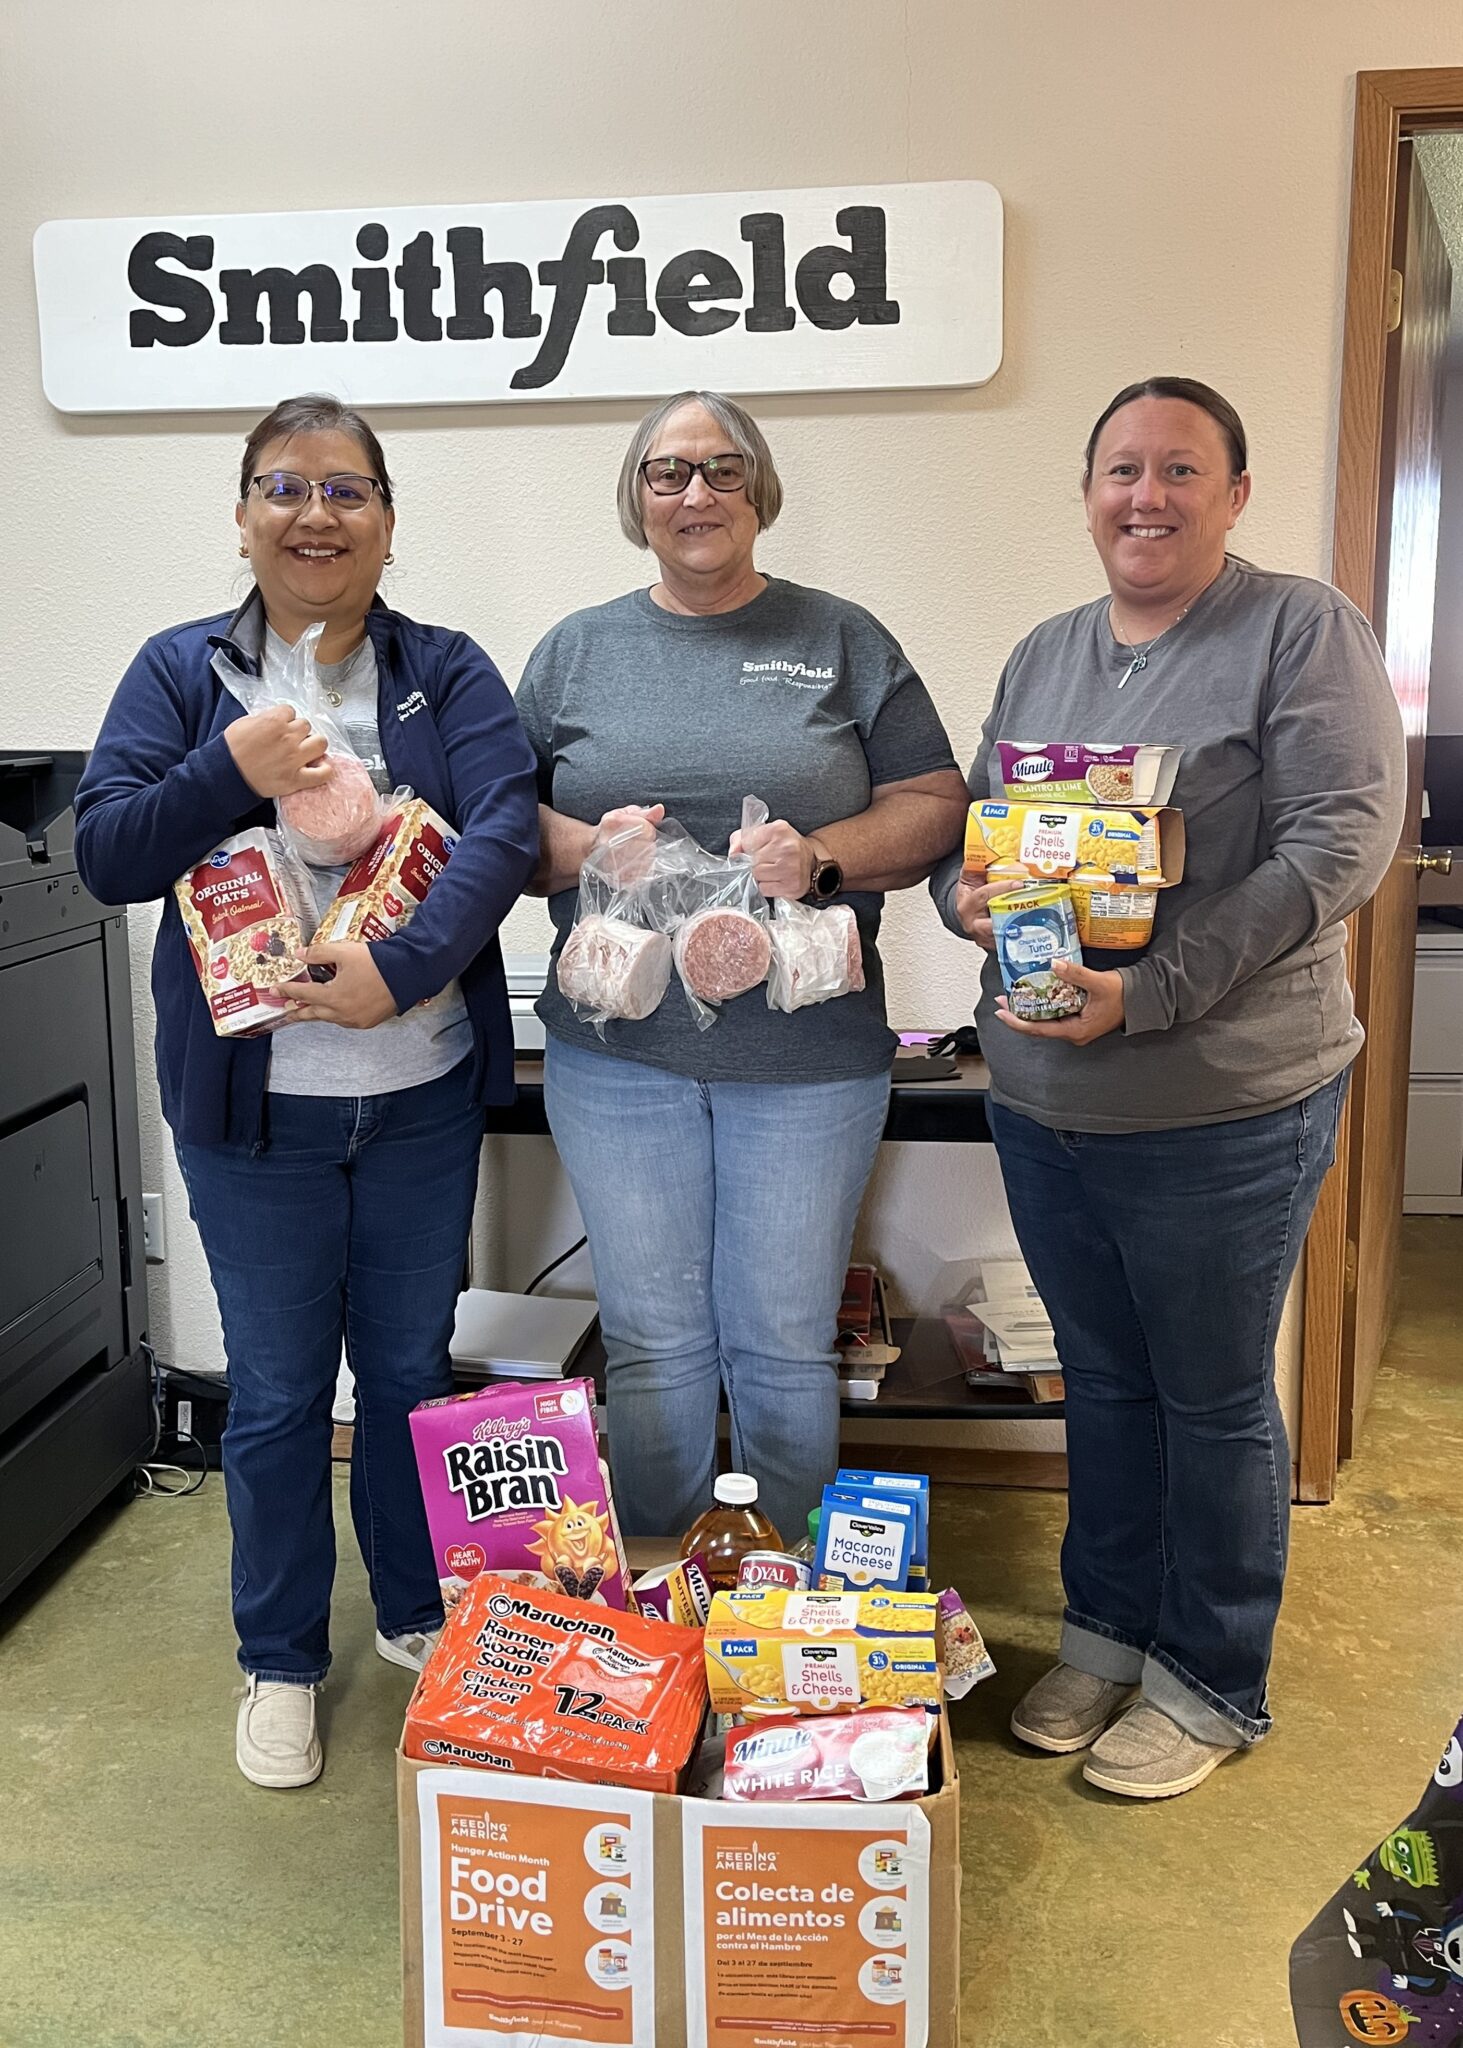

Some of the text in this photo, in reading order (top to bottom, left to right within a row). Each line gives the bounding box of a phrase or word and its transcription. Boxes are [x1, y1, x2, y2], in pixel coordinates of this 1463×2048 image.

[127, 204, 900, 390] Smithfield
[1012, 758, 1054, 779] Minute
[1013, 782, 1083, 793] CILANTRO & LIME
[984, 808, 1006, 816] 4 PACK
[1034, 835, 1065, 848] Shells
[1032, 848, 1071, 860] Cheese
[195, 871, 263, 901] ORIGINAL
[213, 888, 250, 906] OATS
[1014, 900, 1040, 910] PACK
[1028, 942, 1053, 954] Tuna
[473, 1416, 531, 1440] Kellogg's
[446, 1437, 565, 1487] Raisin
[465, 1474, 558, 1518] Bran
[452, 1550, 476, 1560] HEART
[834, 1537, 896, 1557] Macaroni
[450, 1557, 481, 1568] HEALTHY
[831, 1550, 893, 1570] & Cheese
[742, 1565, 789, 1584] ROYAL
[675, 1575, 692, 1616] BUTTER
[511, 1598, 616, 1643] Maruchan
[799, 1616, 850, 1625] Cheese
[802, 1608, 841, 1616] Shells
[483, 1619, 554, 1653] Ramen
[475, 1631, 550, 1666] Noodle
[725, 1644, 754, 1655] 4 PACK
[477, 1652, 533, 1677] Soup
[462, 1670, 532, 1693] Chicken
[802, 1670, 842, 1683] Shells
[463, 1683, 520, 1705] Flavor
[791, 1683, 853, 1697] & Cheese
[555, 1686, 651, 1735] 12 PACK
[438, 1741, 515, 1770] Maruchan
[733, 1728, 813, 1763] Minute
[733, 1763, 846, 1793] WHITE RICE
[451, 1818, 508, 1833] FEEDING
[451, 1827, 508, 1842] AMERICA
[451, 1843, 550, 1867] Hunger Action Month
[716, 1851, 777, 1861] FEEDING
[715, 1861, 777, 1872] AMERICA
[451, 1856, 547, 1902] Food
[715, 1881, 854, 1903] Colecta de
[450, 1890, 553, 1936] Drive
[716, 1907, 846, 1928] alimentos
[451, 1927, 499, 1943] September
[500, 1934, 506, 1943] 3
[512, 1936, 523, 1947] 27
[716, 1933, 828, 1944] por el Mes de la Acción
[751, 1942, 759, 1950] el
[761, 1943, 801, 1951] Hambre
